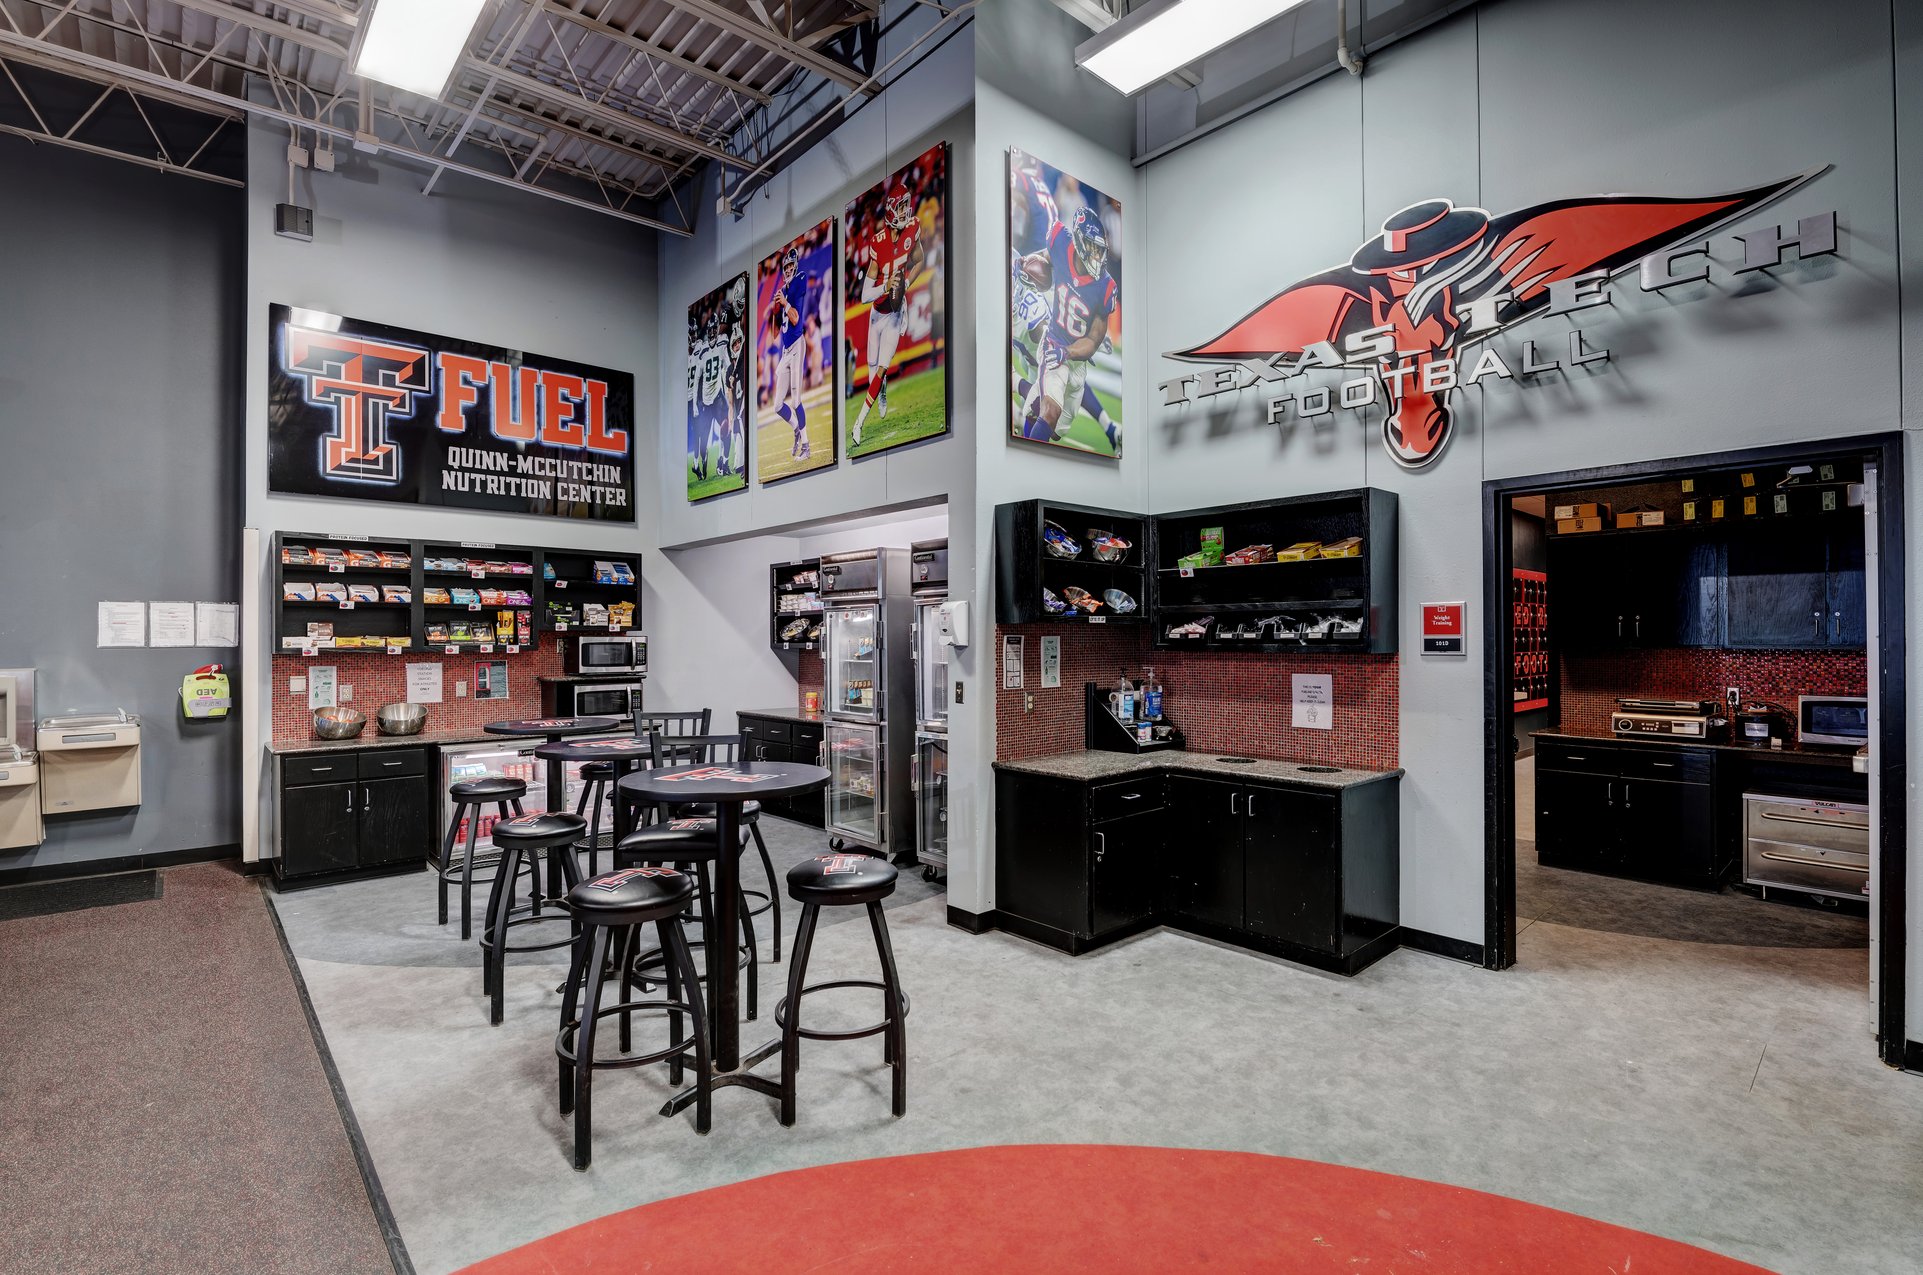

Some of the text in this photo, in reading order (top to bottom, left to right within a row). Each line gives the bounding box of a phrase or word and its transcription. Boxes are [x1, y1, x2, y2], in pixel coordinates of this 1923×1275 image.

[1056, 284, 1090, 339] 16
[1158, 211, 1837, 406] TEXAS TECH
[705, 356, 720, 381] 93
[1267, 329, 1610, 425] FOOTBALL
[438, 351, 628, 454] FUEL
[442, 470, 627, 506] NUTRITION CENTER
[448, 446, 621, 484] QUINN-MCCUTCHIN
[196, 688, 217, 696] AED
